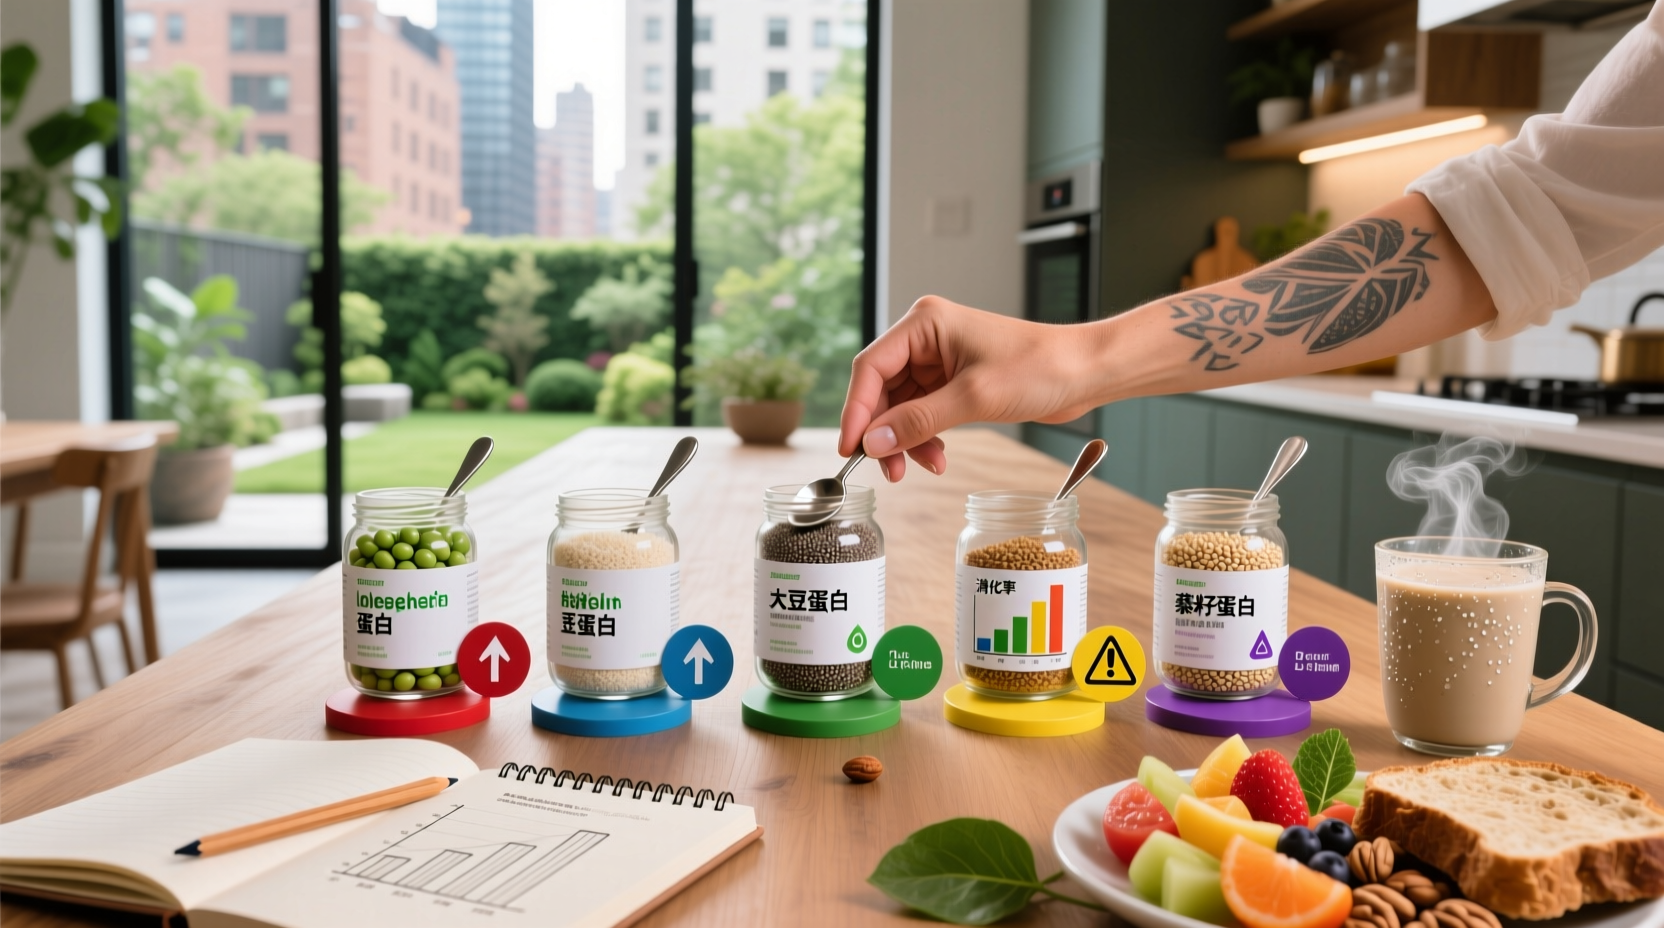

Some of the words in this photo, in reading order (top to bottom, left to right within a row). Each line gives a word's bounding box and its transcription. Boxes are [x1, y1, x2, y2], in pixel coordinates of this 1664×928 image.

[769, 588, 848, 613] 大豆蛋白
[357, 612, 392, 635] 蛋白
